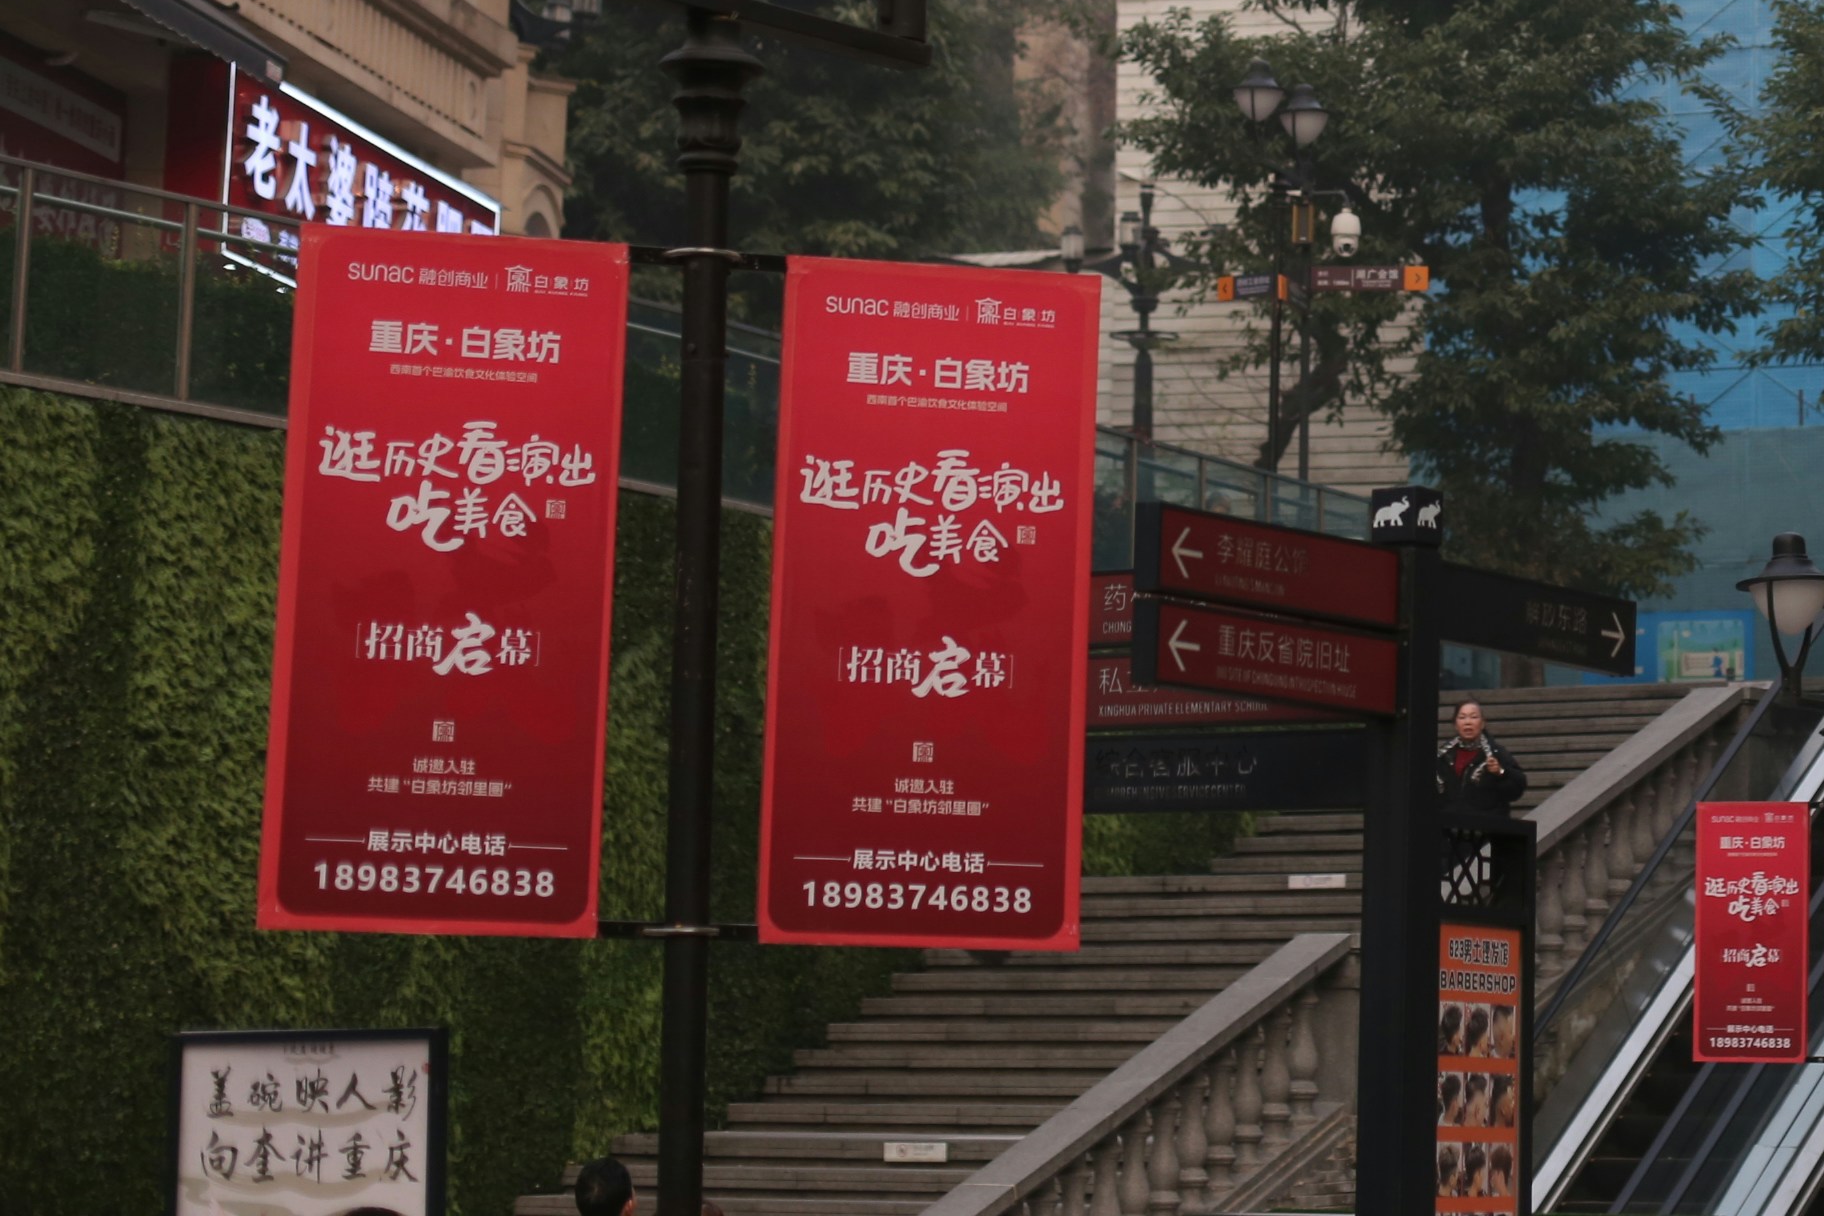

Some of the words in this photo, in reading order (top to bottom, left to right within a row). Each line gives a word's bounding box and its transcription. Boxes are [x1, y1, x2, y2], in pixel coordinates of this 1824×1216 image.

[348, 262, 414, 284] sunac
[418, 266, 488, 290] 融创商业
[826, 295, 888, 317] sunac
[893, 301, 959, 322] 融创商业
[369, 321, 561, 364] 重庆·白象坊
[847, 352, 1030, 394] 重庆·白象坊
[319, 421, 596, 487] 逛历史看演出
[800, 449, 1064, 513] 逛历史看演出
[386, 482, 536, 552] 吃美食
[865, 508, 1009, 577] 吃美食
[1218, 624, 1350, 674] 重庆反省院旧址
[1098, 703, 1137, 718] XINGHUA
[1138, 702, 1173, 717] PRIVATE
[1175, 700, 1232, 715] ELEMENTARY
[413, 758, 476, 775] 诚邀入驻
[894, 779, 954, 795] 诚邀入驻
[367, 830, 506, 856] 展示中心电话
[853, 849, 985, 874] 展示中心电话
[313, 863, 555, 898] 18983746838
[802, 881, 1033, 914] 18983746838
[1728, 896, 1780, 921] 吃美食
[1440, 971, 1516, 993] BARBERSHOP
[1710, 1038, 1791, 1048] 18983746838
